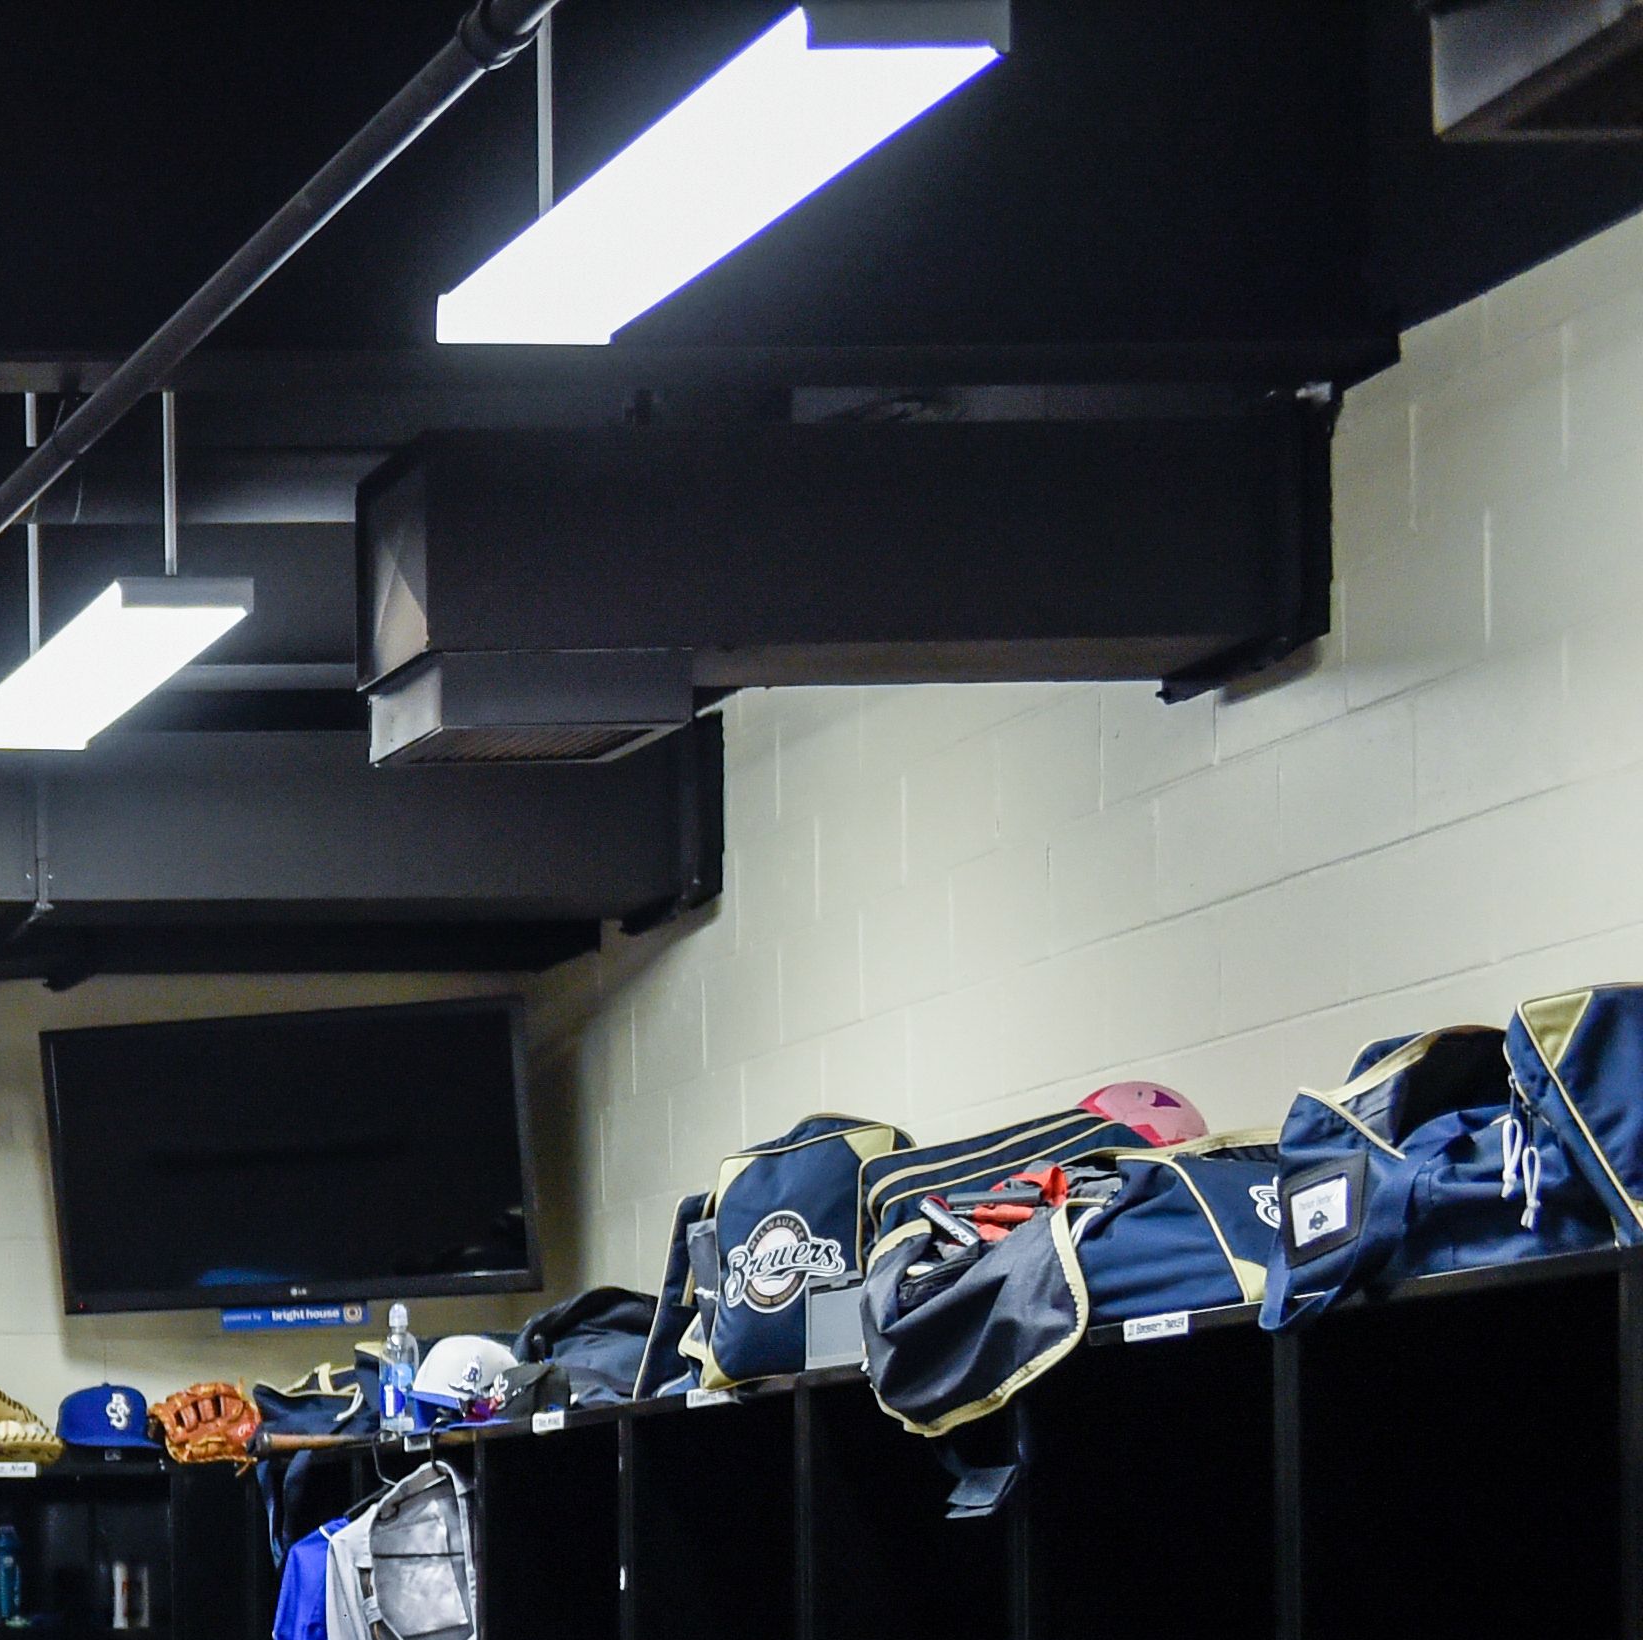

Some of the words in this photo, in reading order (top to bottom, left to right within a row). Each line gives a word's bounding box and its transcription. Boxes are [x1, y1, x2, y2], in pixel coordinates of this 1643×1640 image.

[749, 1216, 805, 1251] MILWAUKEE
[727, 1241, 843, 1305] Brewers
[271, 1309, 305, 1322] bright
[306, 1307, 340, 1320] house
